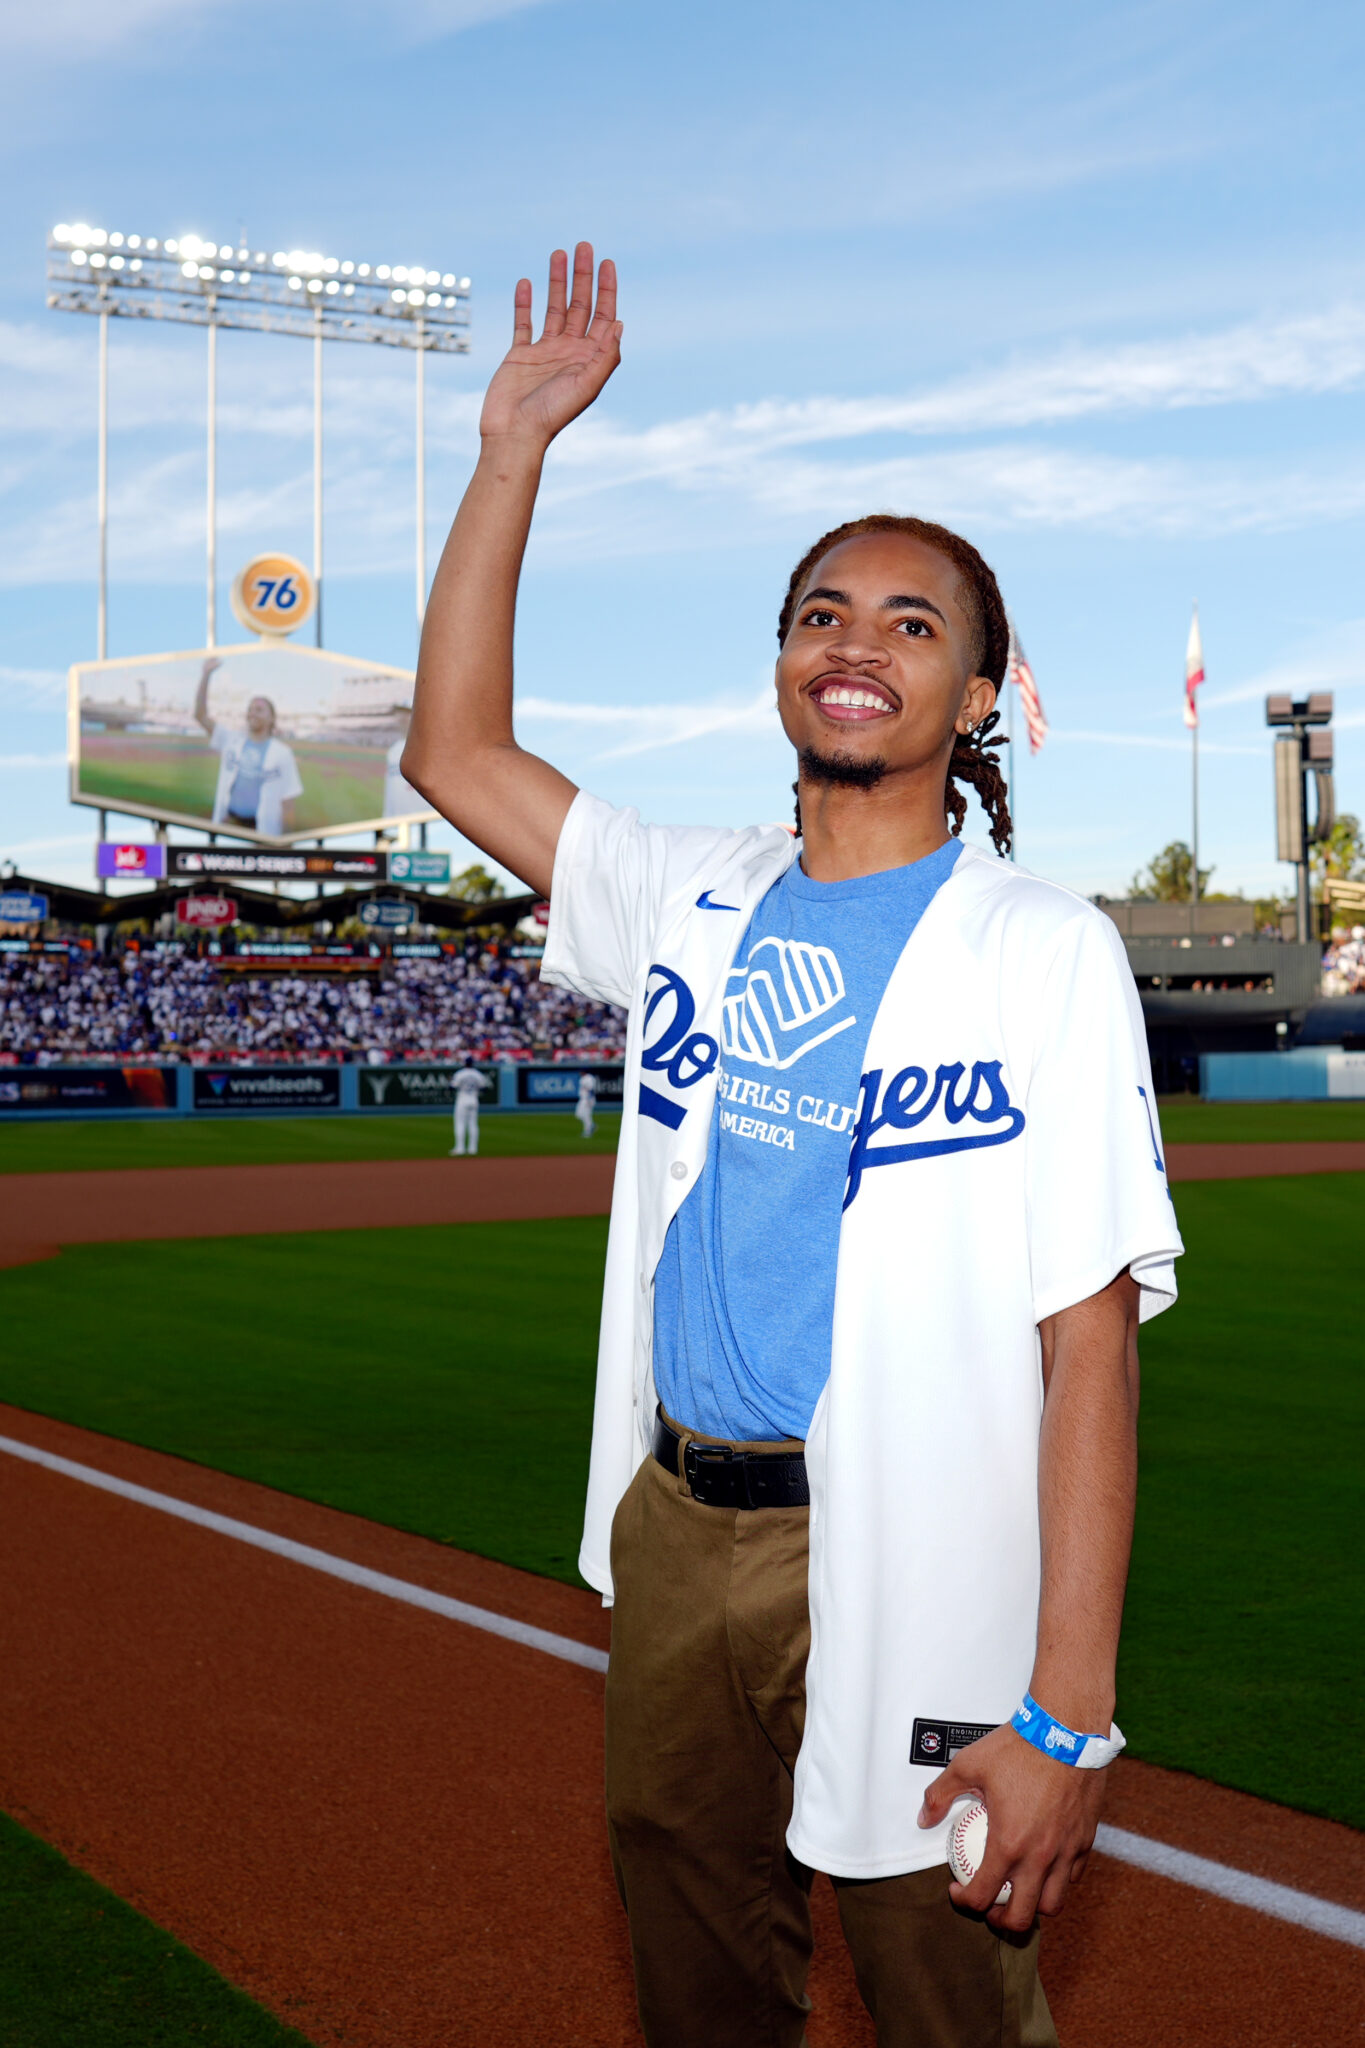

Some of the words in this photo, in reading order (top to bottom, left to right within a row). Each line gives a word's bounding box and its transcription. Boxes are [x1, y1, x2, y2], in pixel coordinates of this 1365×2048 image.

[255, 577, 298, 610] 76
[202, 854, 255, 872] WORLD
[257, 855, 306, 874] SERIES
[229, 1075, 324, 1093] vividseats
[533, 1078, 575, 1093] UCLA
[720, 1073, 791, 1115] GIRLS
